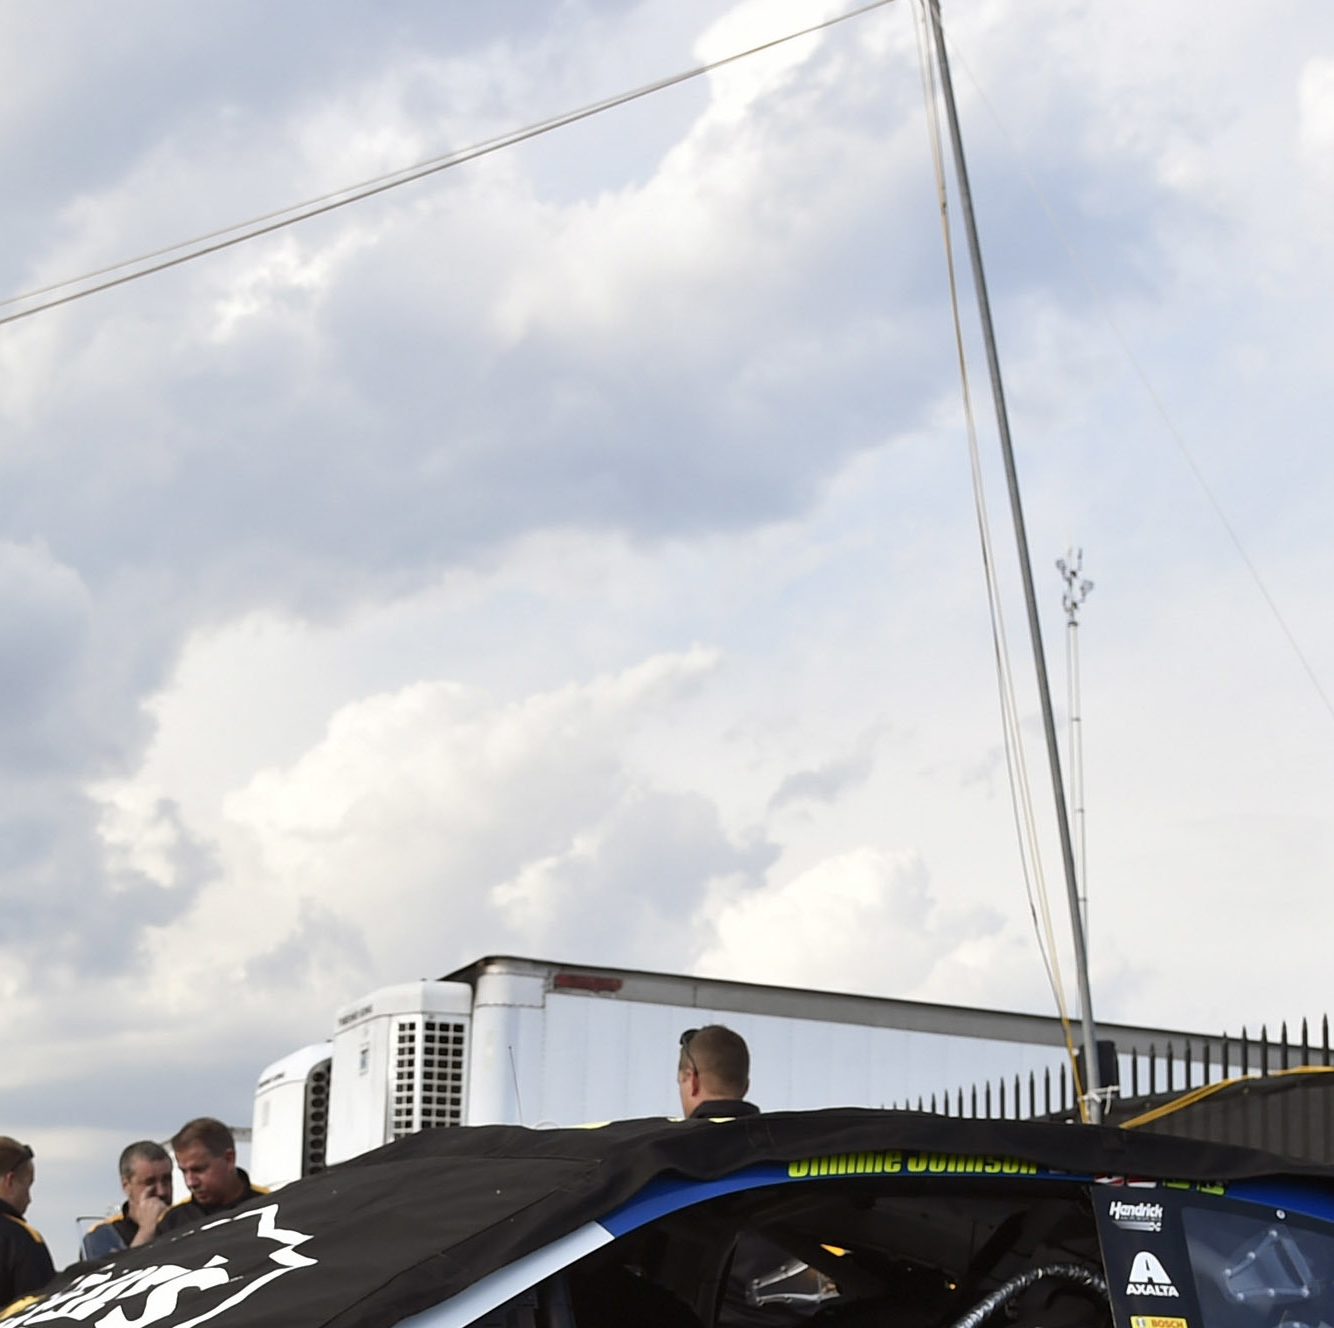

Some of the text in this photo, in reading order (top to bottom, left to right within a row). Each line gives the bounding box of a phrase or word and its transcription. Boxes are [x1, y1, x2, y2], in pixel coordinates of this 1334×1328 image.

[1109, 1201, 1163, 1220] Hendrick
[1126, 1283, 1180, 1298] AXALTA
[1151, 1319, 1184, 1328] BOSCH
